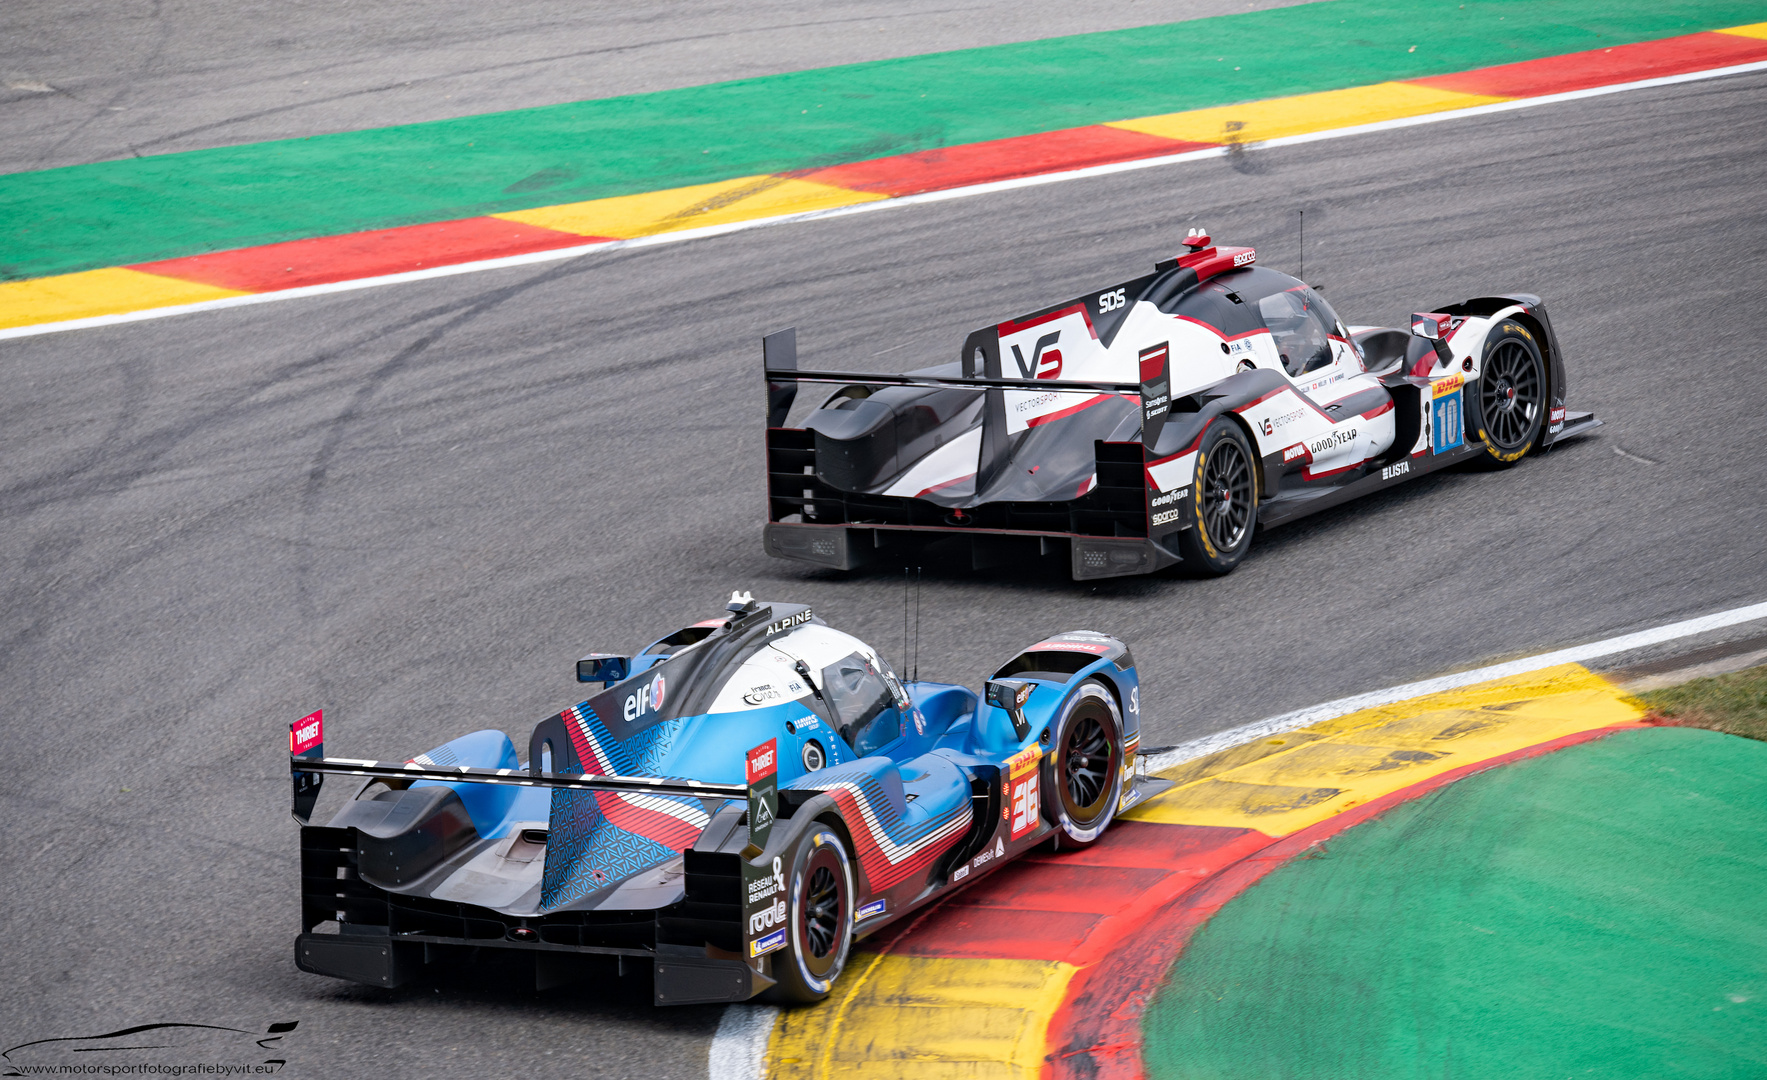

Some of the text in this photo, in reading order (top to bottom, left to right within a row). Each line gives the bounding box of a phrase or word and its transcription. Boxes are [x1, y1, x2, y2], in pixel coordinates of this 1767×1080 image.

[1233, 250, 1256, 266] sparco
[1098, 287, 1126, 314] SDS
[1437, 376, 1461, 394] DHL
[1437, 398, 1458, 447] 10
[1311, 428, 1357, 454] GOODYEAR
[1284, 443, 1306, 463] MOTUL
[1388, 461, 1410, 479] LISTA
[1151, 487, 1189, 508] GOODYEAR
[1152, 508, 1179, 526] sparco
[766, 608, 812, 637] ALPINE
[789, 682, 802, 693] FIA
[1016, 686, 1028, 704] elf
[623, 683, 651, 722] elf
[295, 720, 320, 746] THIRIET
[751, 749, 775, 774] THIRIET
[1013, 750, 1038, 772] DHL
[748, 875, 773, 894] RÉSEAU
[748, 883, 779, 904] RENAULT
[749, 897, 787, 935] roole
